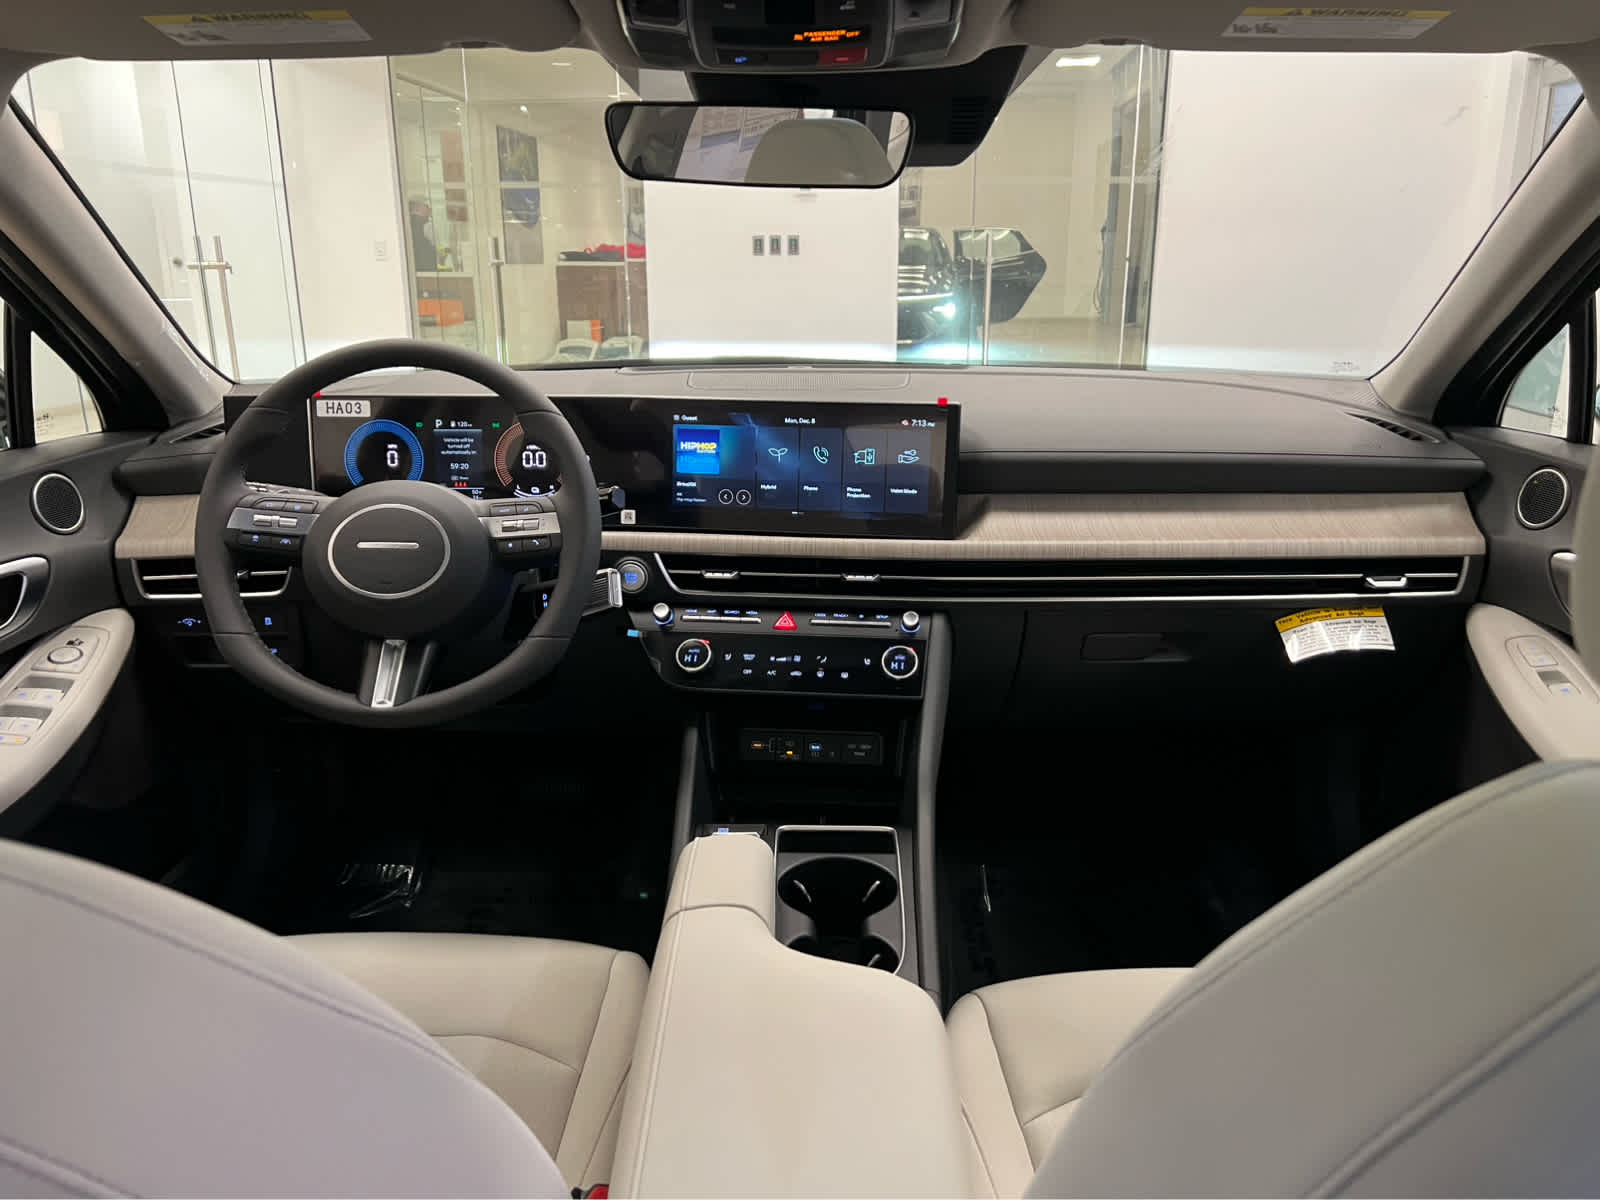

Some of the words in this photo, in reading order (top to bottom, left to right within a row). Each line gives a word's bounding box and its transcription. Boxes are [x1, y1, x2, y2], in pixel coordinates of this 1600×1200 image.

[803, 29, 847, 37] PASSENGER
[326, 402, 362, 415] HA03
[435, 419, 443, 429] P
[911, 419, 927, 427] 7:13
[386, 450, 399, 468] 0
[450, 462, 470, 470] 59:20
